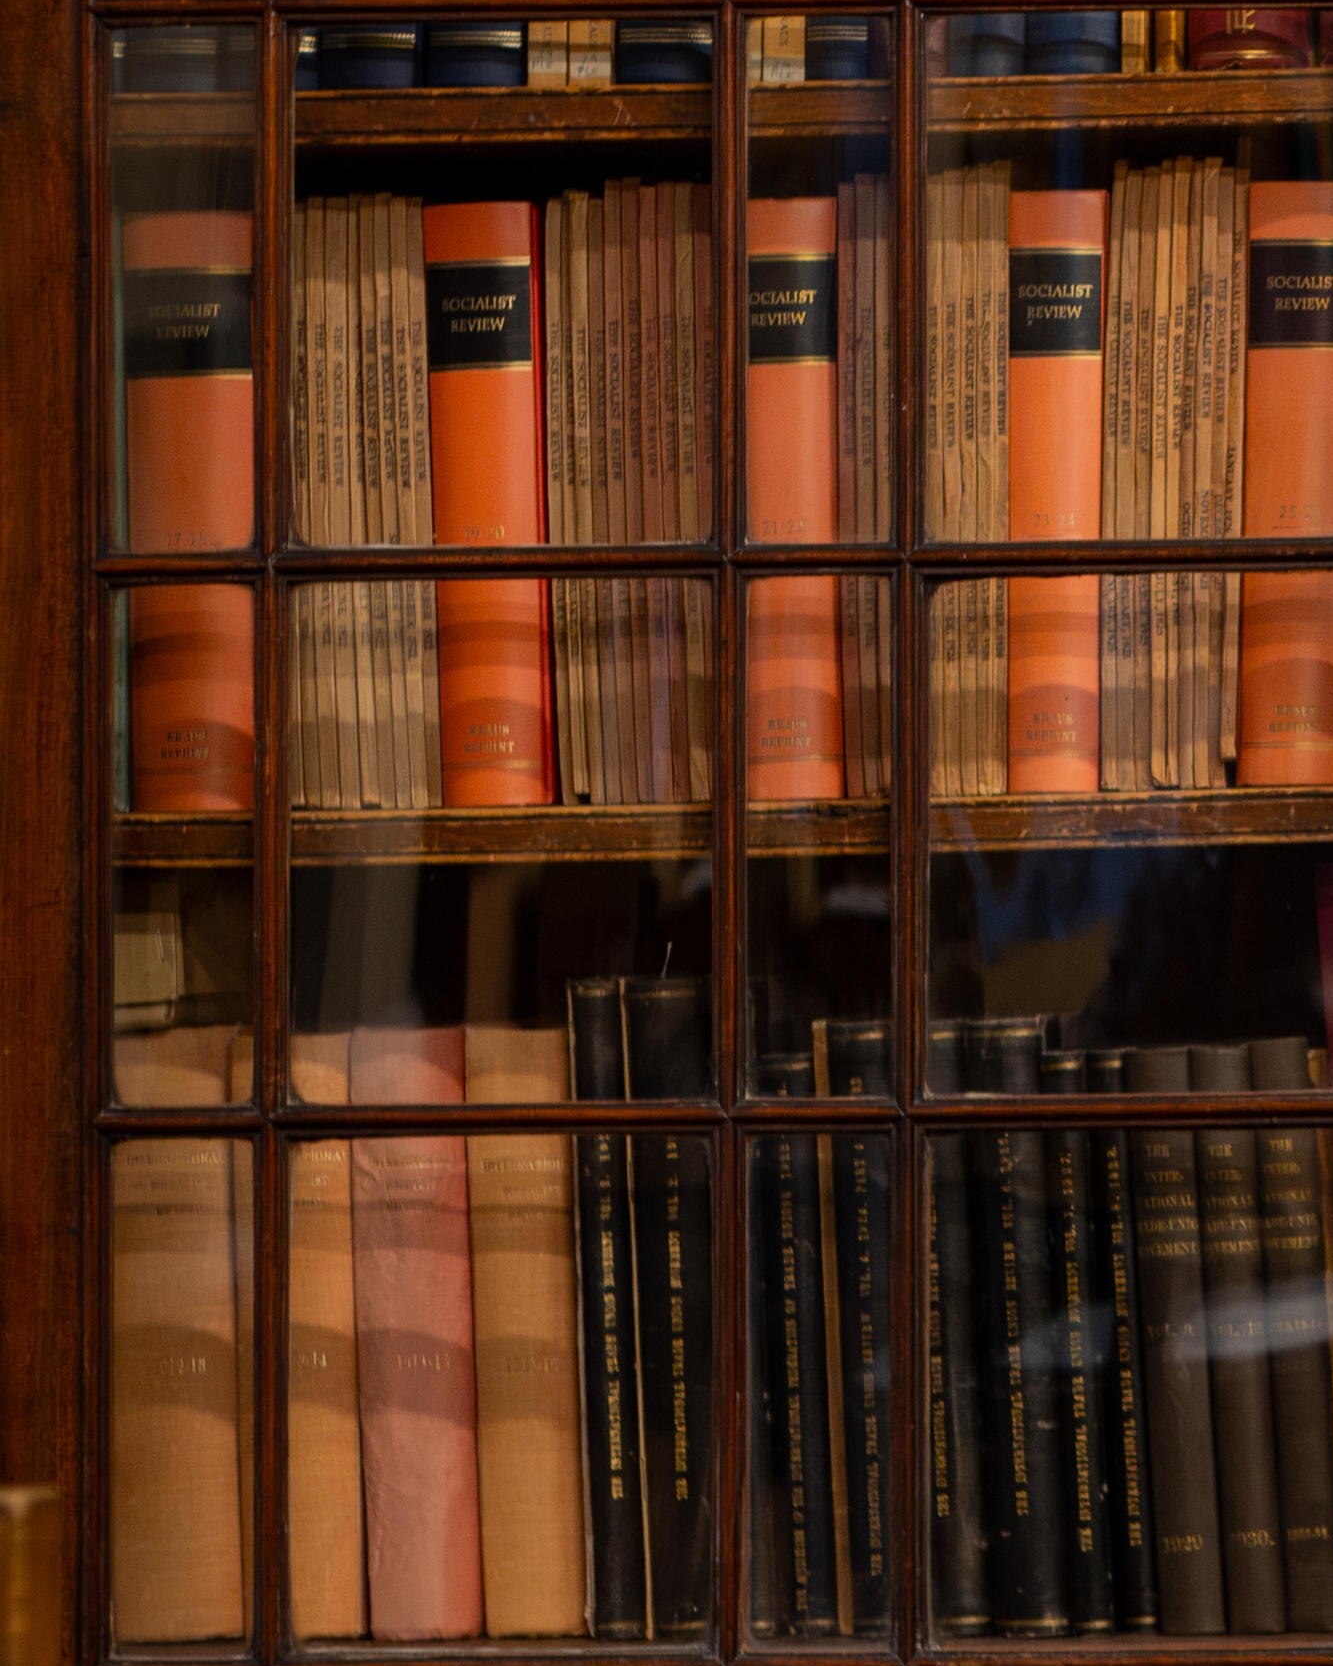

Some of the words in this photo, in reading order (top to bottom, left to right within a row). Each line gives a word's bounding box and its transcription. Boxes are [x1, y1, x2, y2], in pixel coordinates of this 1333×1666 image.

[750, 289, 817, 306] OCIALIST
[1018, 283, 1094, 300] SOCIALIST
[1274, 296, 1331, 311] REVIEW
[750, 311, 806, 327] REVIEW
[1026, 305, 1083, 320] REVIEW
[450, 317, 506, 334] REVIEW
